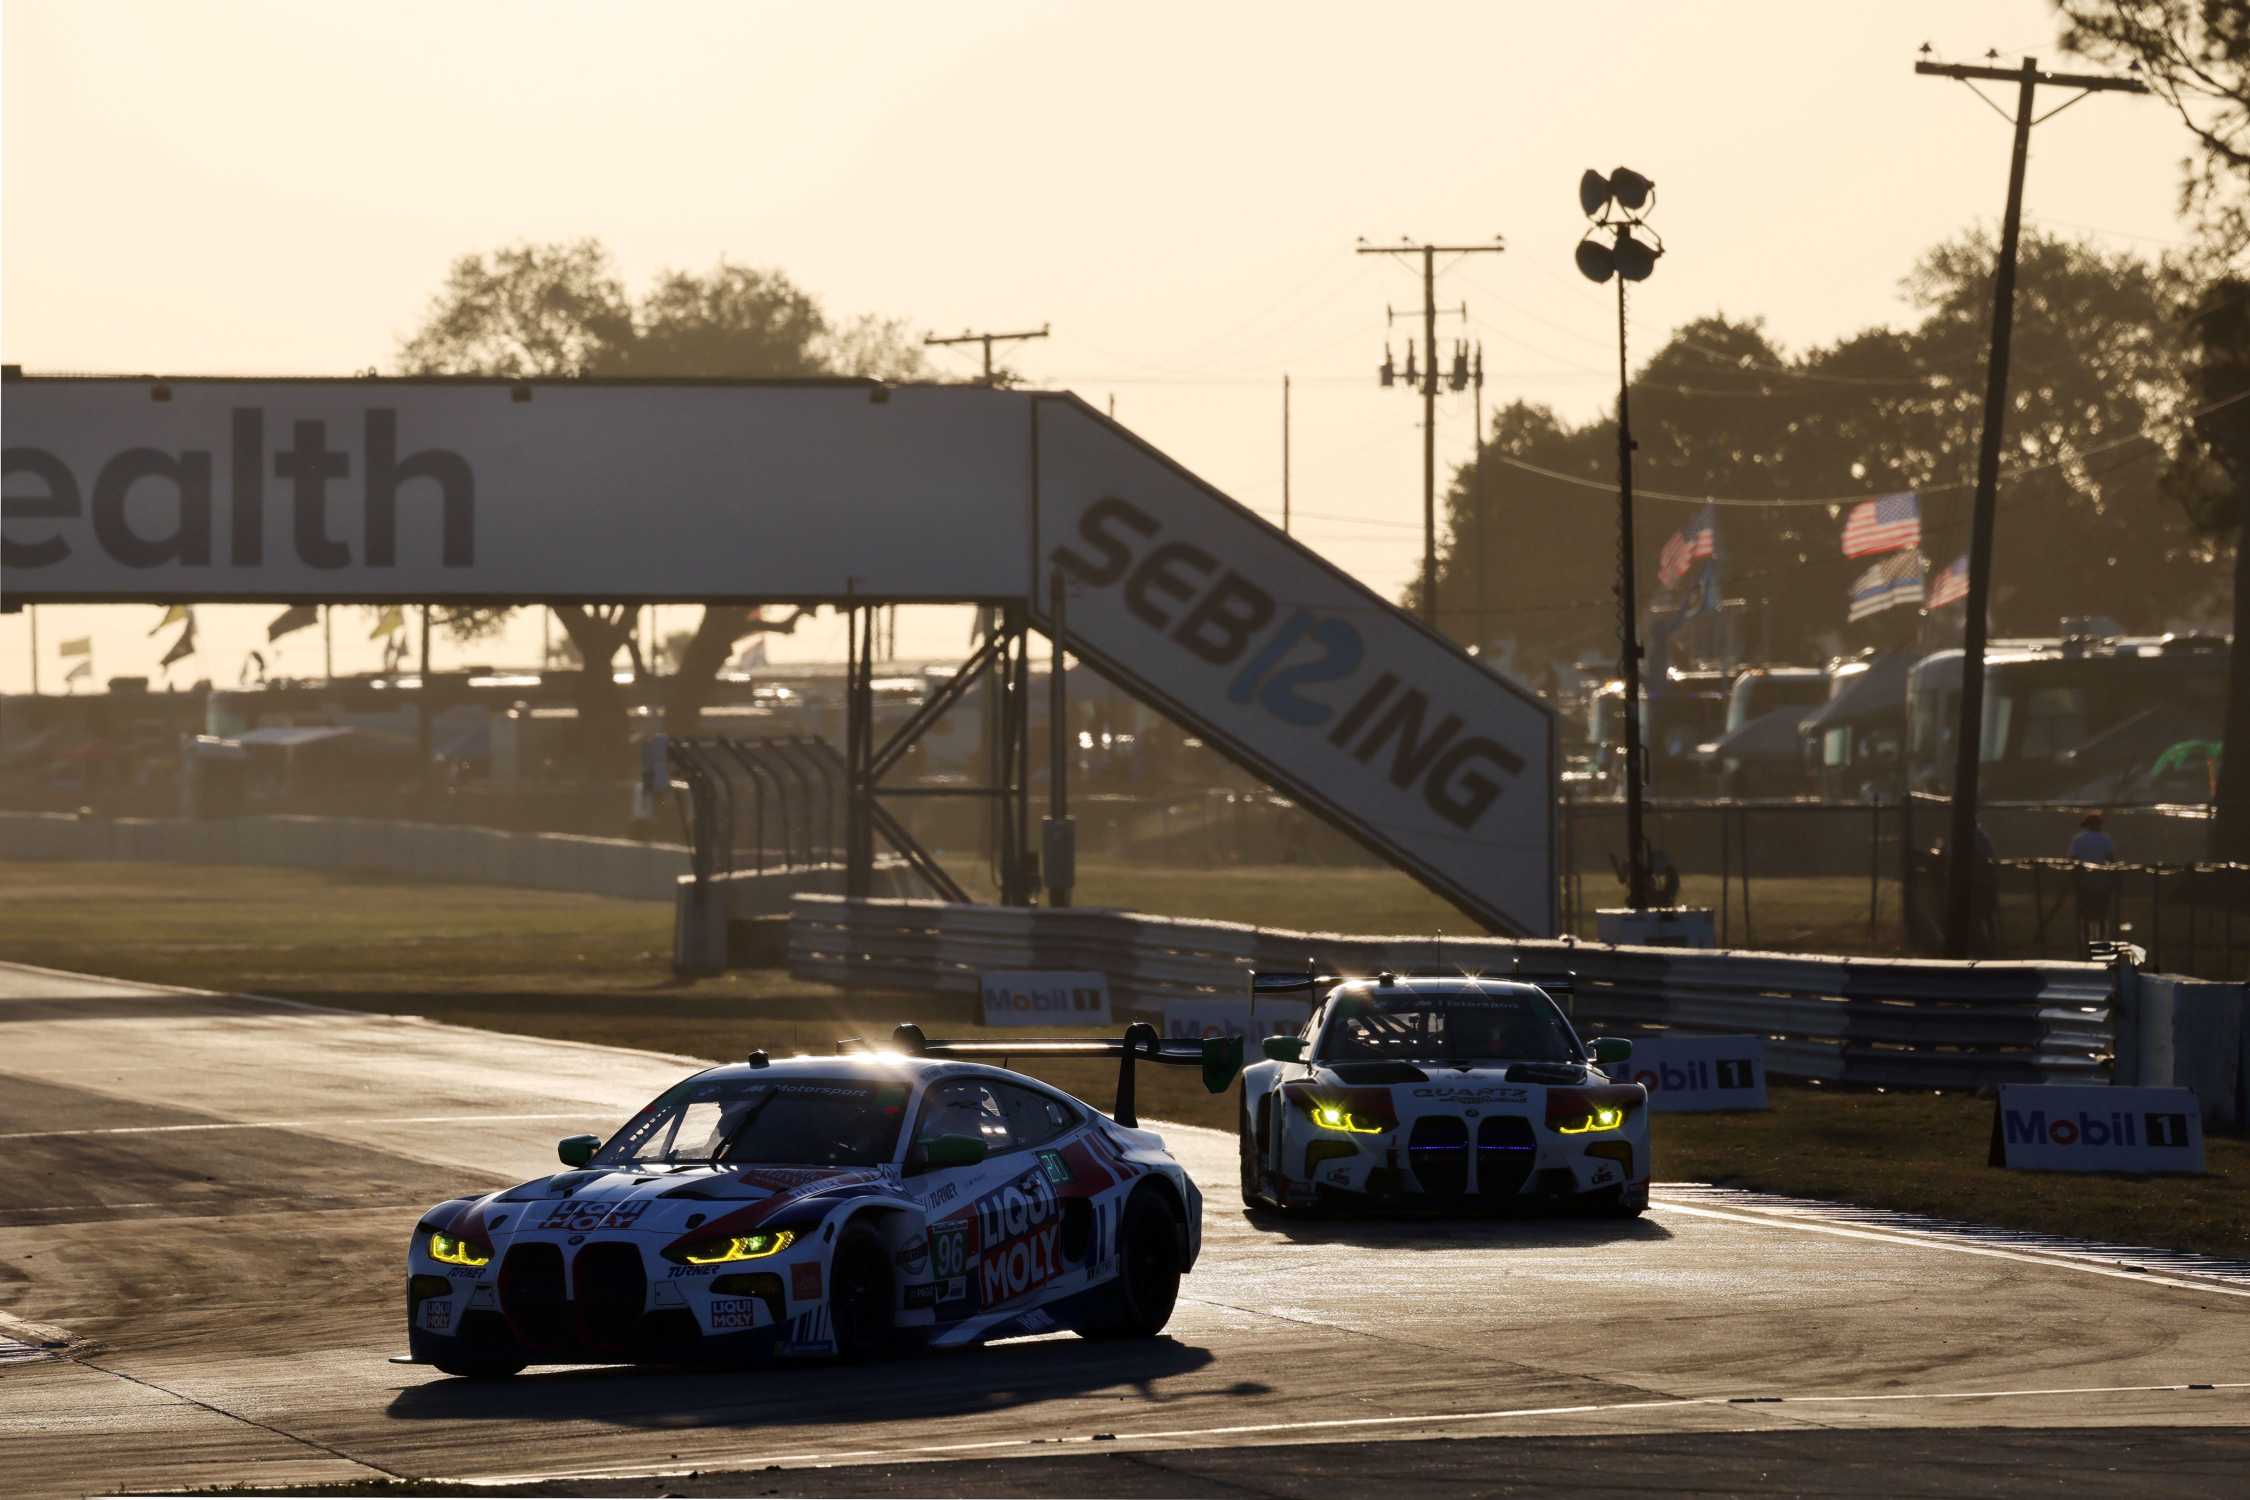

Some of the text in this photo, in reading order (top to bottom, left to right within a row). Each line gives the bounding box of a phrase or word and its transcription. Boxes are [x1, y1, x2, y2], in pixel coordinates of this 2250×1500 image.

[1, 407, 475, 569] ealth
[985, 988, 1070, 1011] Mobil
[1412, 1087, 1529, 1098] QUARTZ
[2005, 1109, 2138, 1147] Mobil
[978, 1169, 1059, 1251] LIQUI
[937, 1232, 967, 1279] 96
[983, 1223, 1058, 1307] MOLY
[668, 1265, 721, 1279] TURNER
[426, 1301, 452, 1313] LIQUI
[713, 1301, 753, 1313] LIQUI
[713, 1314, 753, 1327] MOLY
